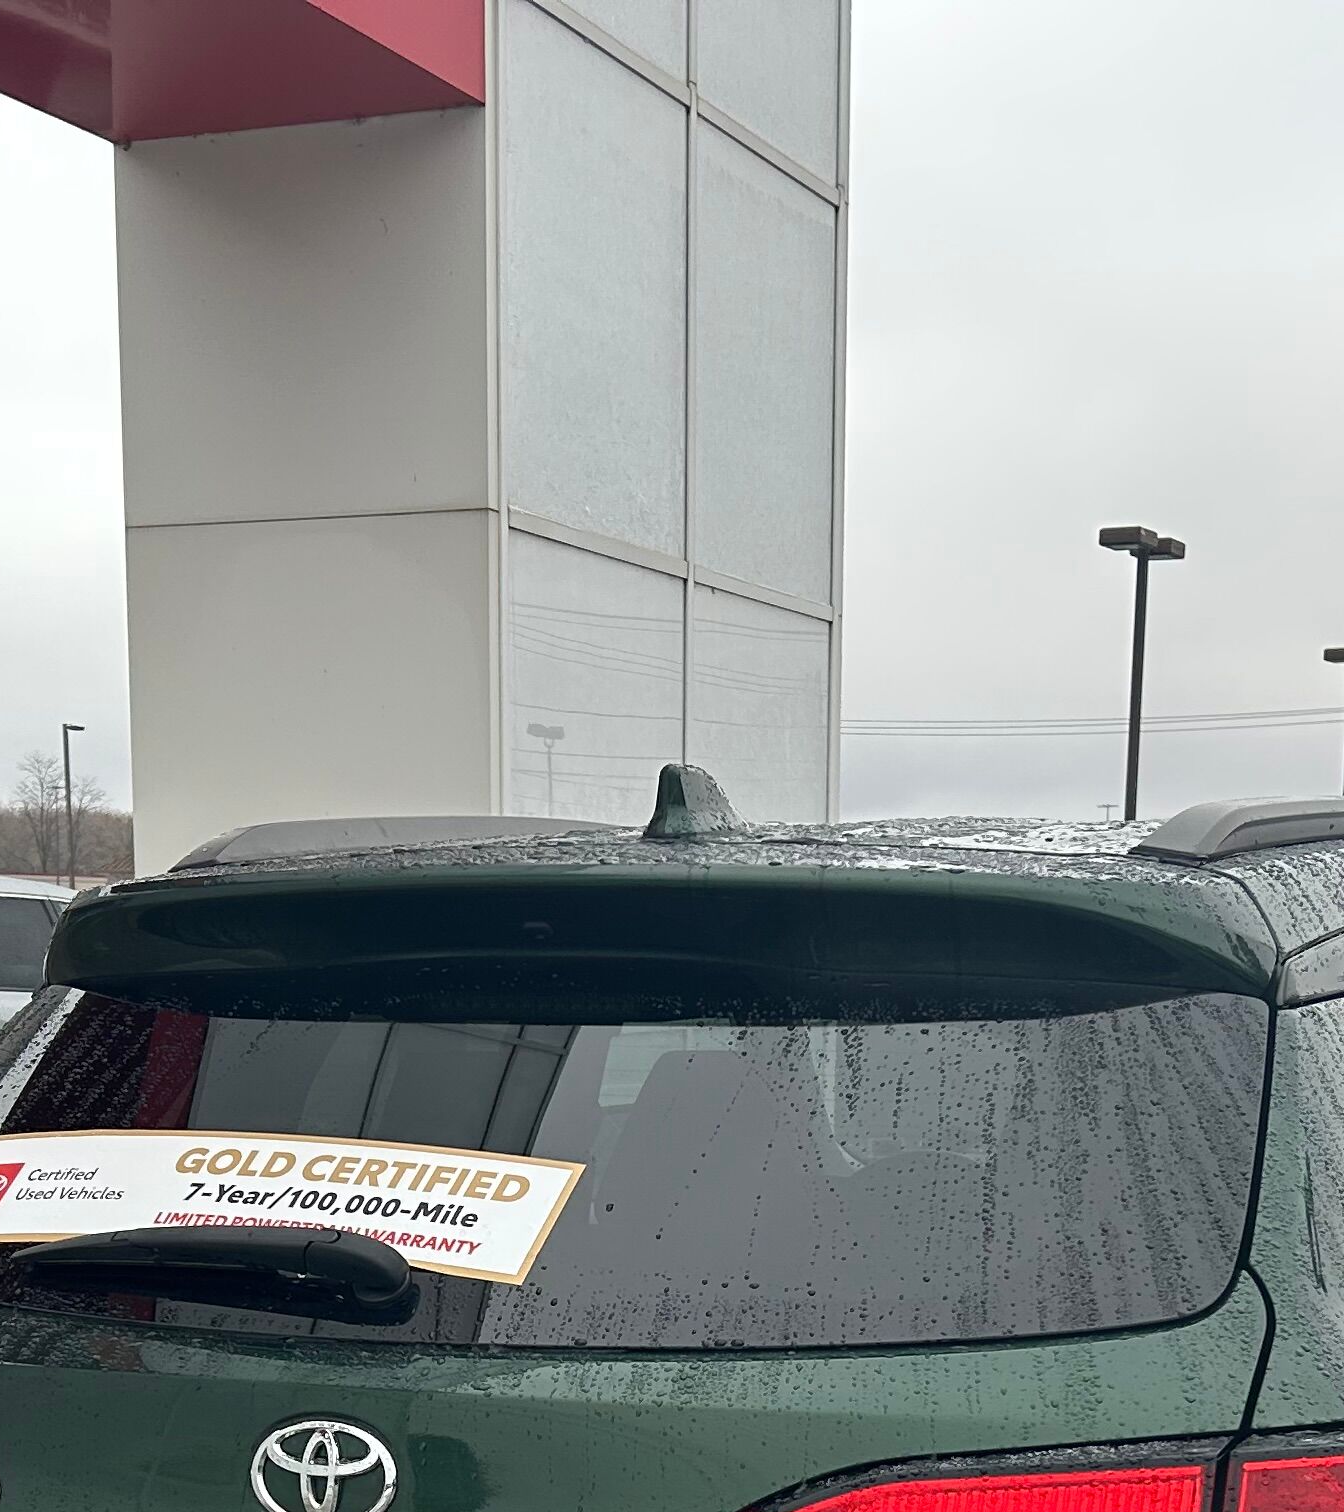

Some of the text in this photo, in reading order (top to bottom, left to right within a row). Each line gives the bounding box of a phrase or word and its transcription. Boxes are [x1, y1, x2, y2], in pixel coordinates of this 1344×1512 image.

[15, 1187, 125, 1200] Used Vehicles
[27, 1167, 99, 1181] Certified
[175, 1147, 531, 1202] GOLD CERTIFIED
[183, 1182, 479, 1228] 7-Year/100,000-Mile
[153, 1212, 228, 1227] LIMITED
[364, 1228, 482, 1255] WARRANTY
